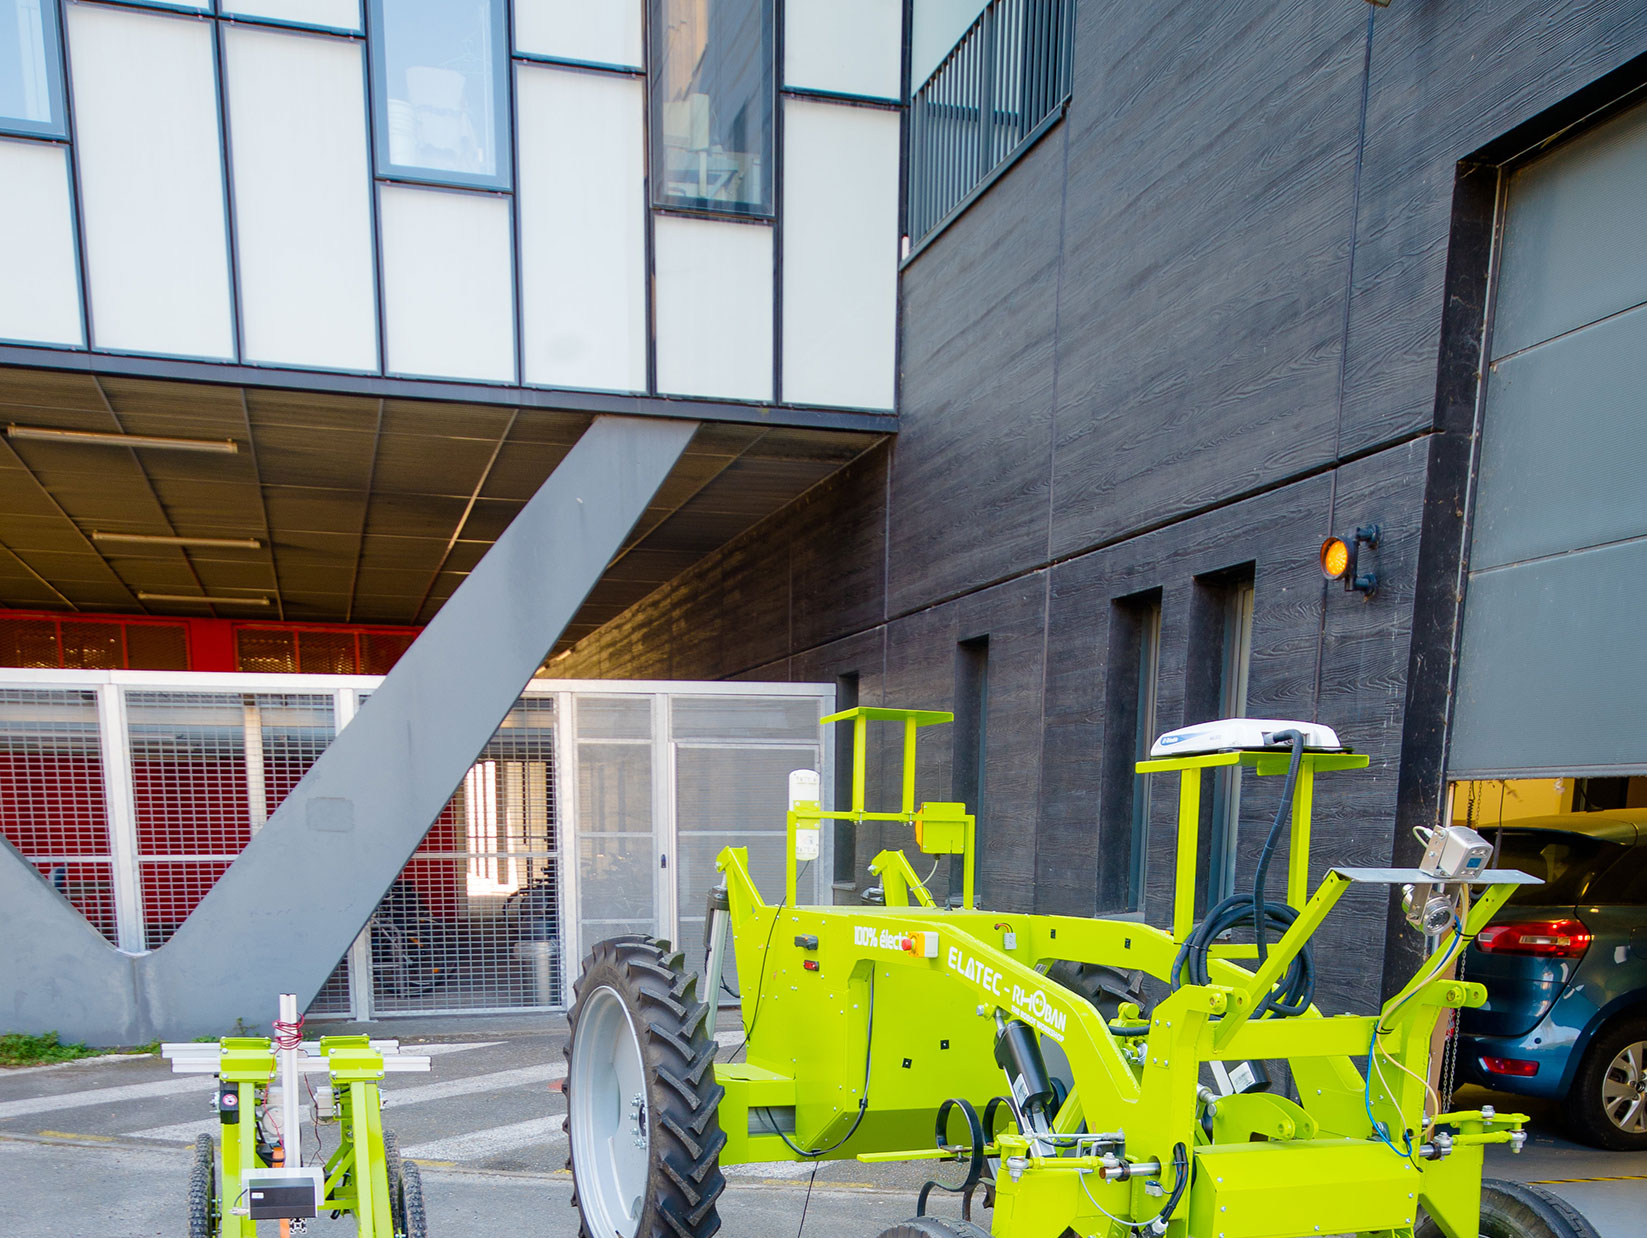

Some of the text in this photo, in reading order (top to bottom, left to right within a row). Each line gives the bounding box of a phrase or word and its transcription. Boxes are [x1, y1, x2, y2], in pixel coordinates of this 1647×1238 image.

[854, 926, 878, 947] 100%
[947, 946, 1003, 997] ELATEC
[1012, 984, 1067, 1033] RHOBAN
